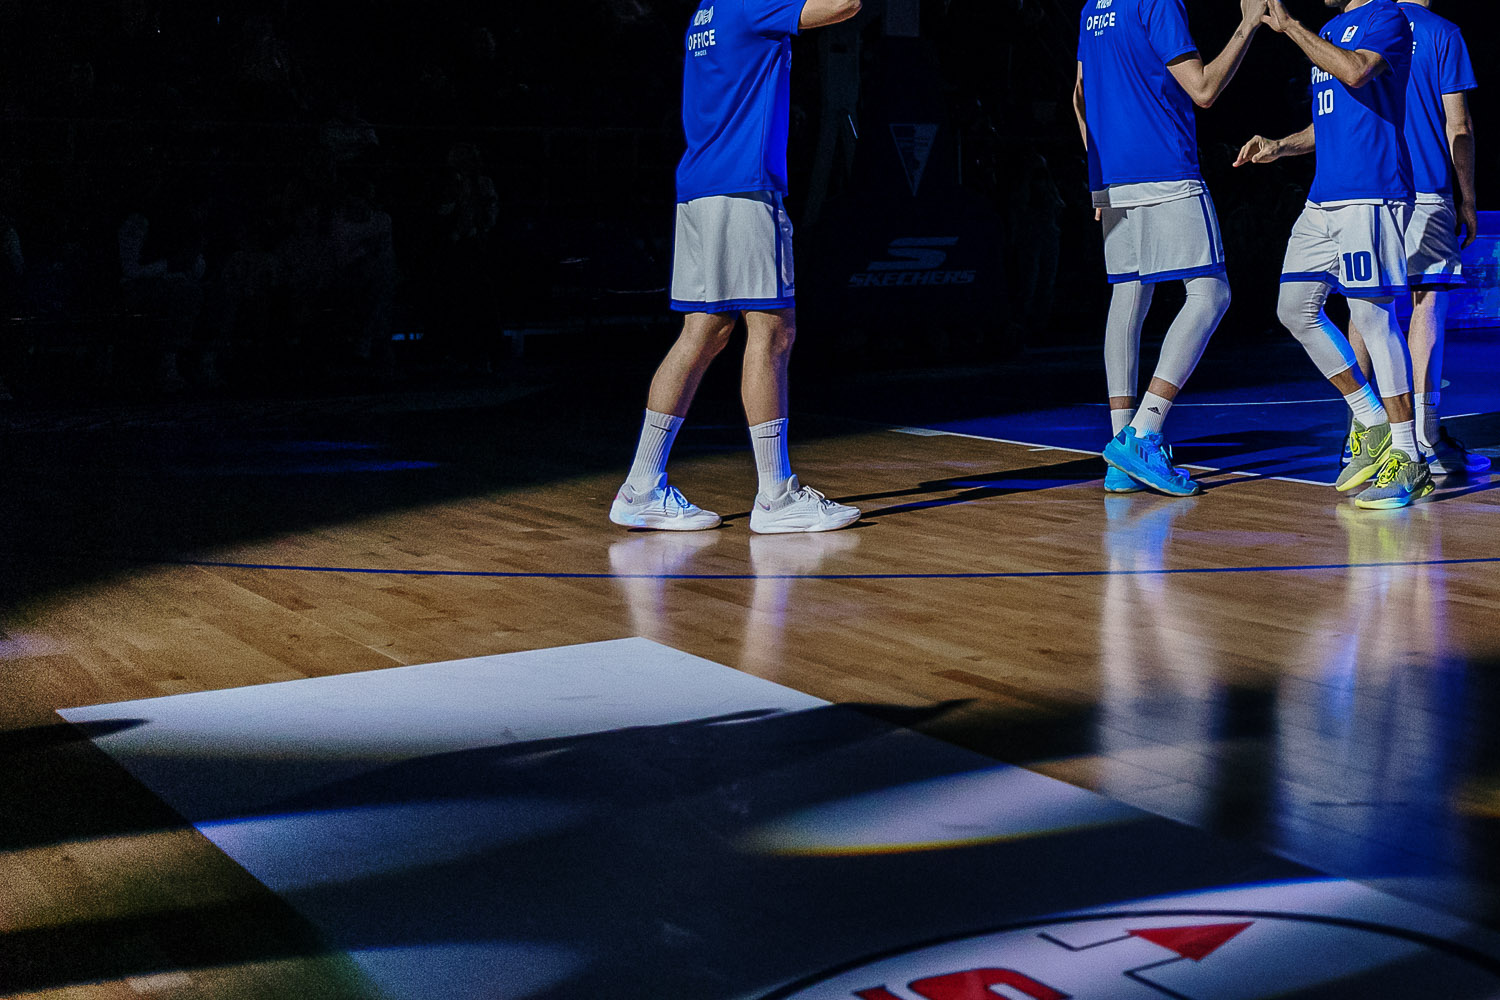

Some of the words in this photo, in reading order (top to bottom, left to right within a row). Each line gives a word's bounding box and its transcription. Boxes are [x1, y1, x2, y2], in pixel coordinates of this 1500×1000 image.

[688, 29, 716, 51] OFFICE
[1317, 89, 1334, 116] 10
[1343, 251, 1372, 281] 10
